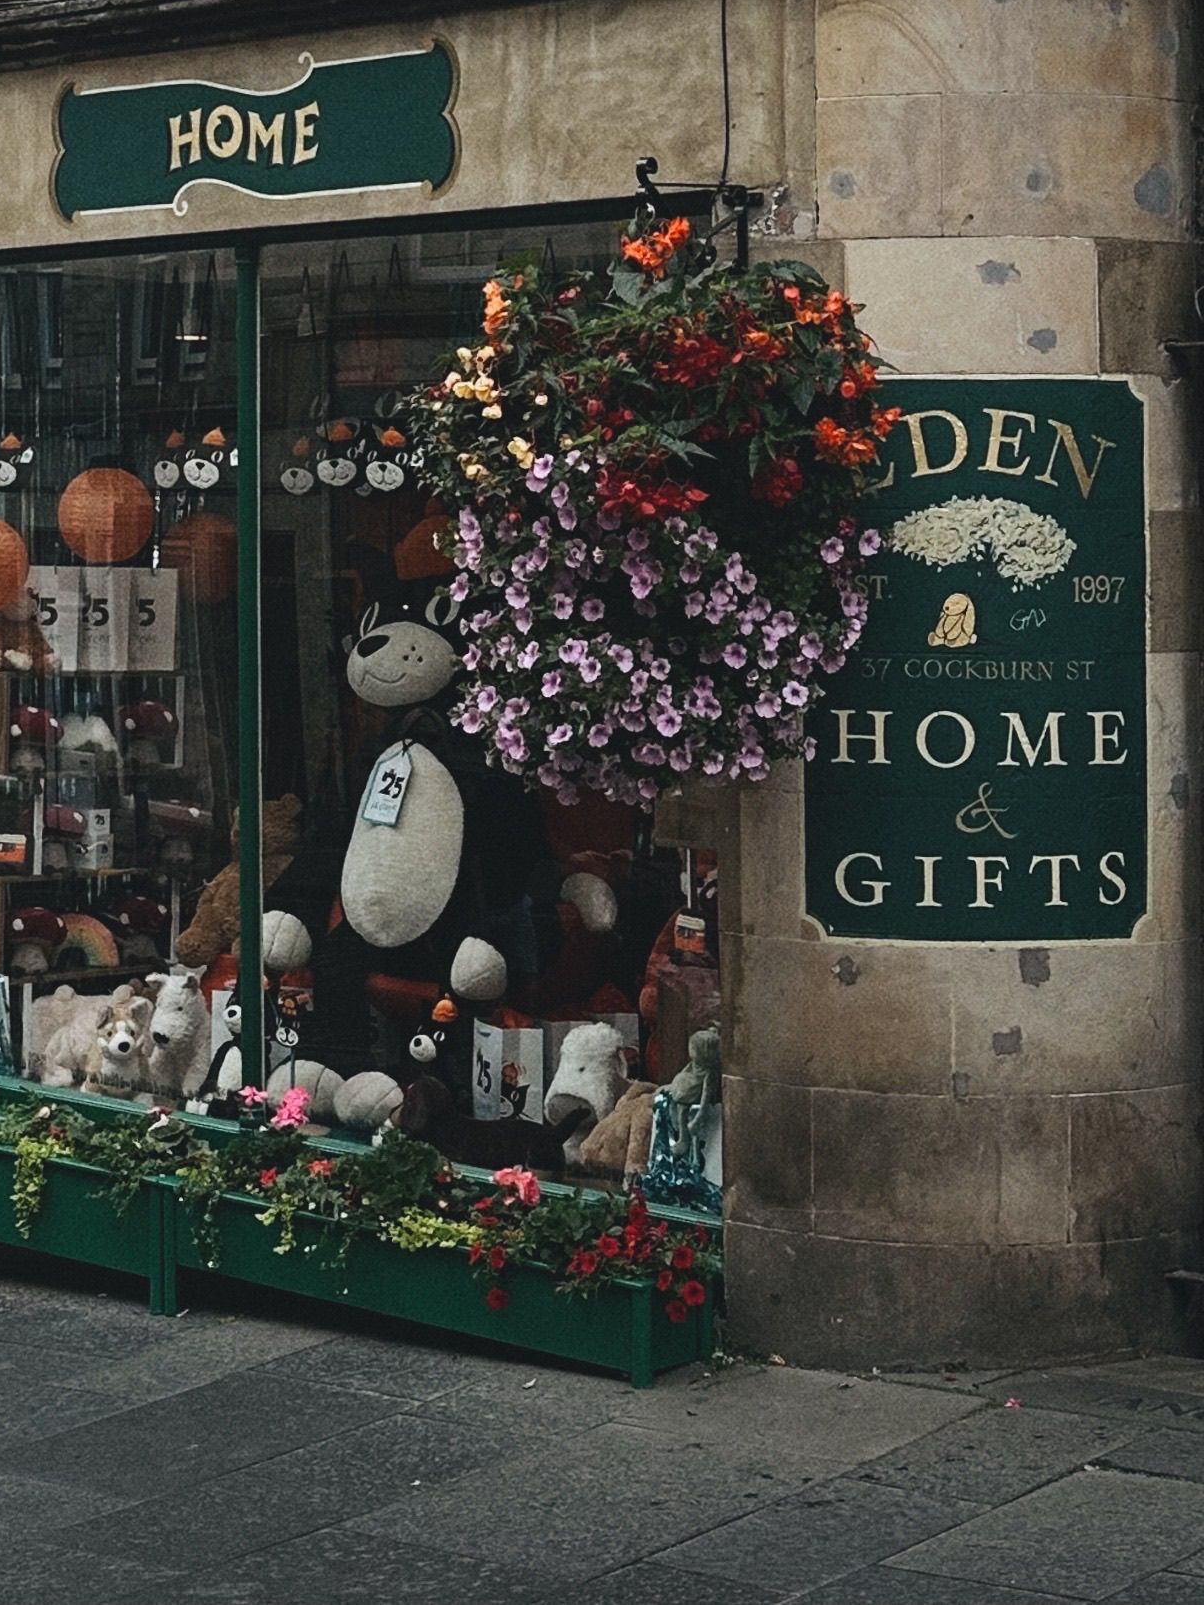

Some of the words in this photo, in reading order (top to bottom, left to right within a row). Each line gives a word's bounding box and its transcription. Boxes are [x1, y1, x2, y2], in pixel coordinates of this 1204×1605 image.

[169, 100, 319, 171] HOME
[1073, 574, 1125, 604] 1997
[861, 658, 892, 681] 37
[904, 658, 1055, 681] COCKBURN
[1066, 660, 1095, 680] ST
[831, 709, 1128, 768] HOME
[379, 771, 405, 799] 25
[956, 782, 1017, 839] &
[835, 852, 1127, 908] GIFTS
[476, 1050, 492, 1094] 25
